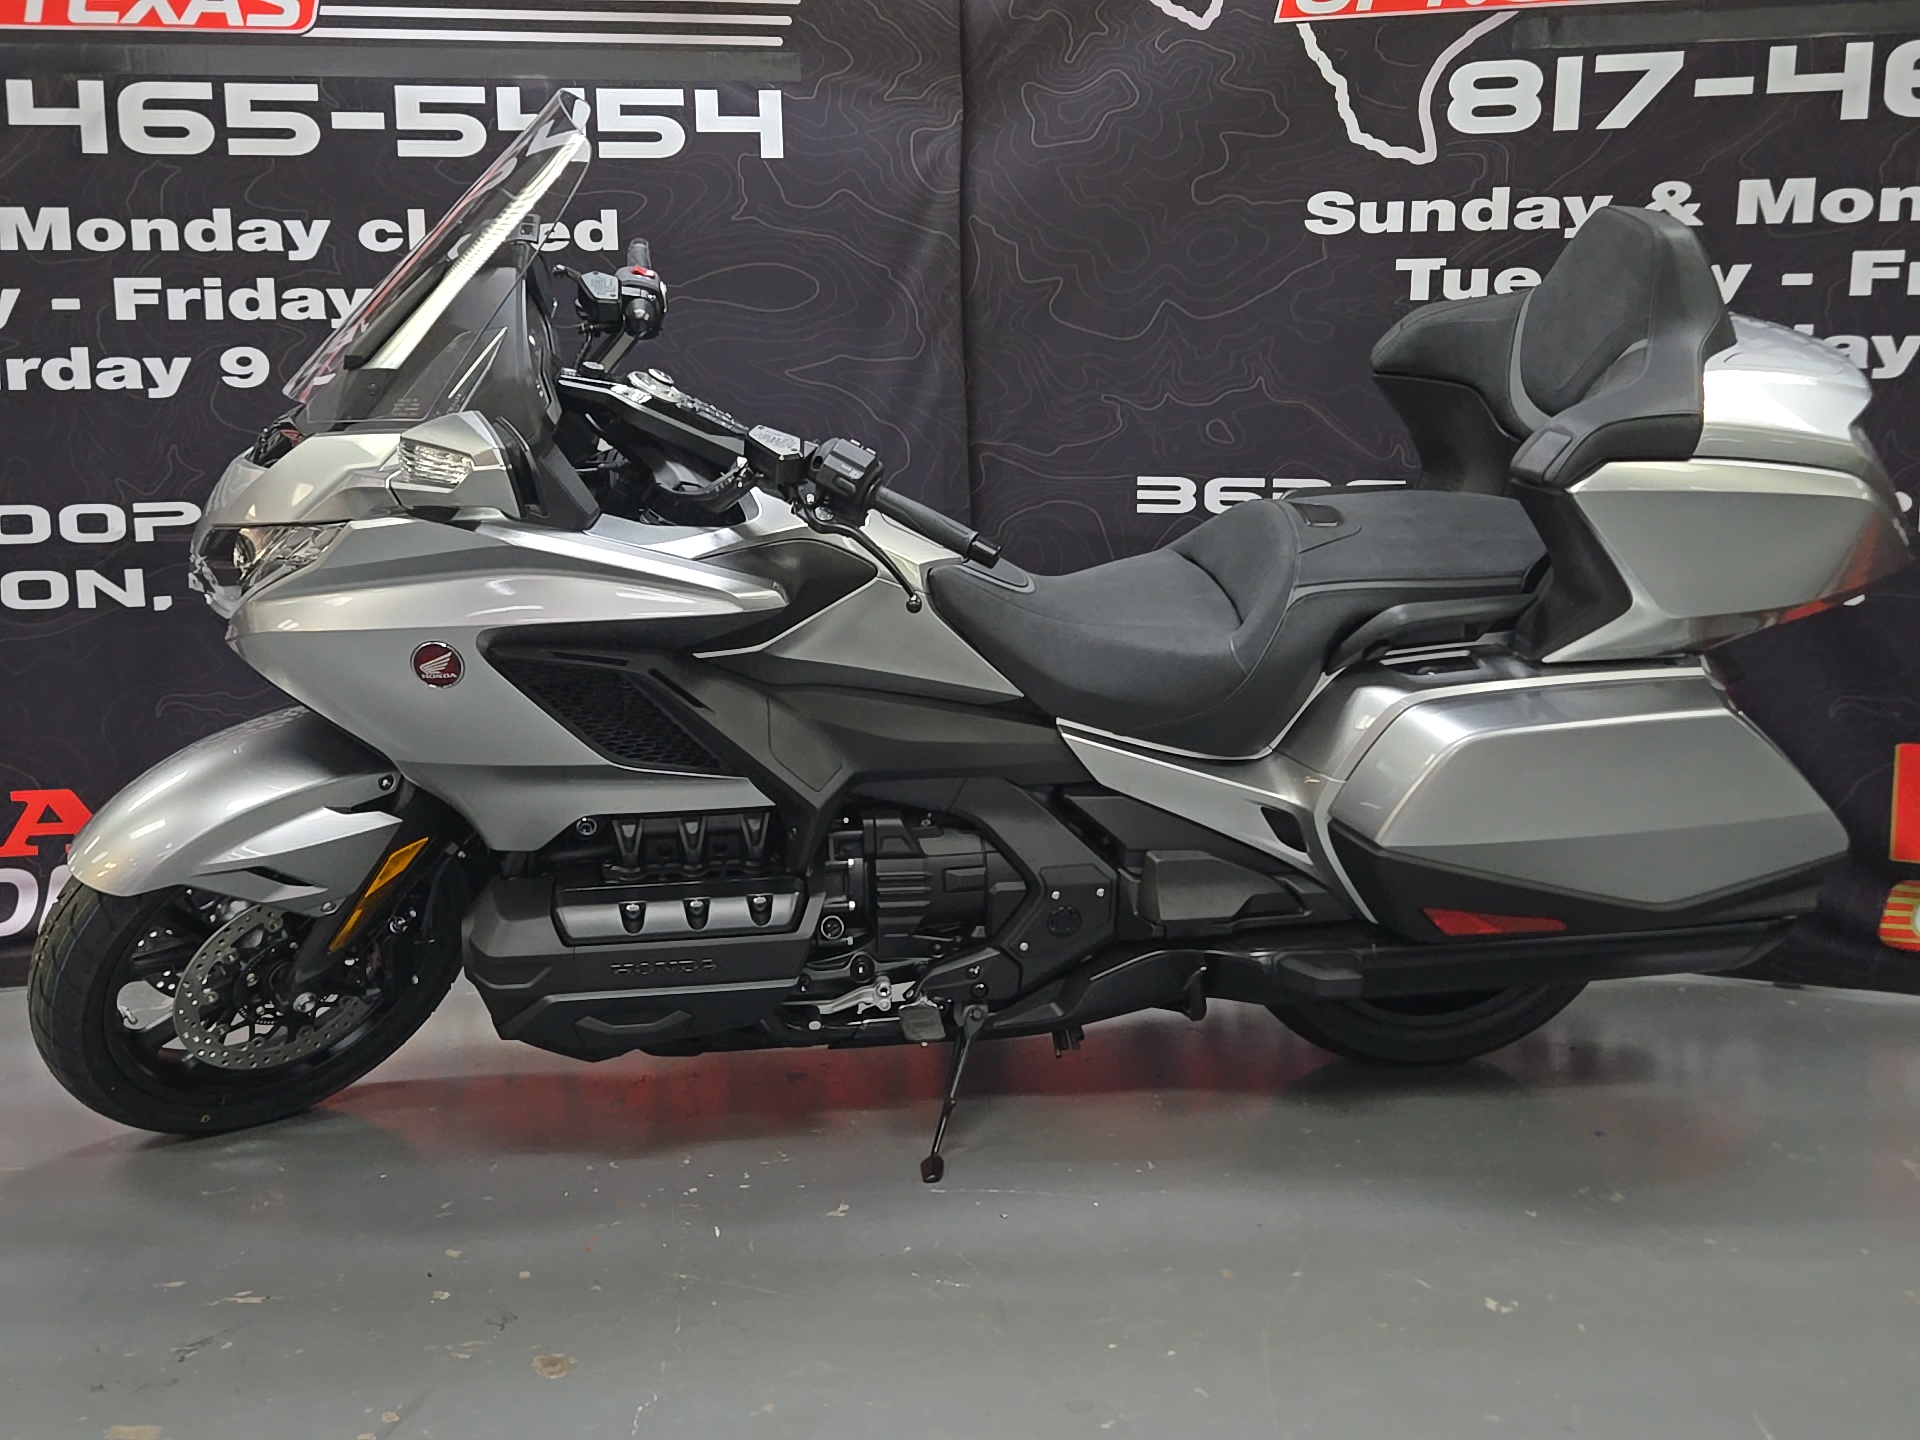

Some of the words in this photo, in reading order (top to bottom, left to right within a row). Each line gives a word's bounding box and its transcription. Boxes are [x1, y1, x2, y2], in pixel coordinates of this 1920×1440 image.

[0, 206, 331, 261] Monday
[1304, 187, 1613, 238] Sunday
[1645, 181, 1704, 226] &
[113, 277, 371, 330] Friday
[220, 346, 270, 388] 9
